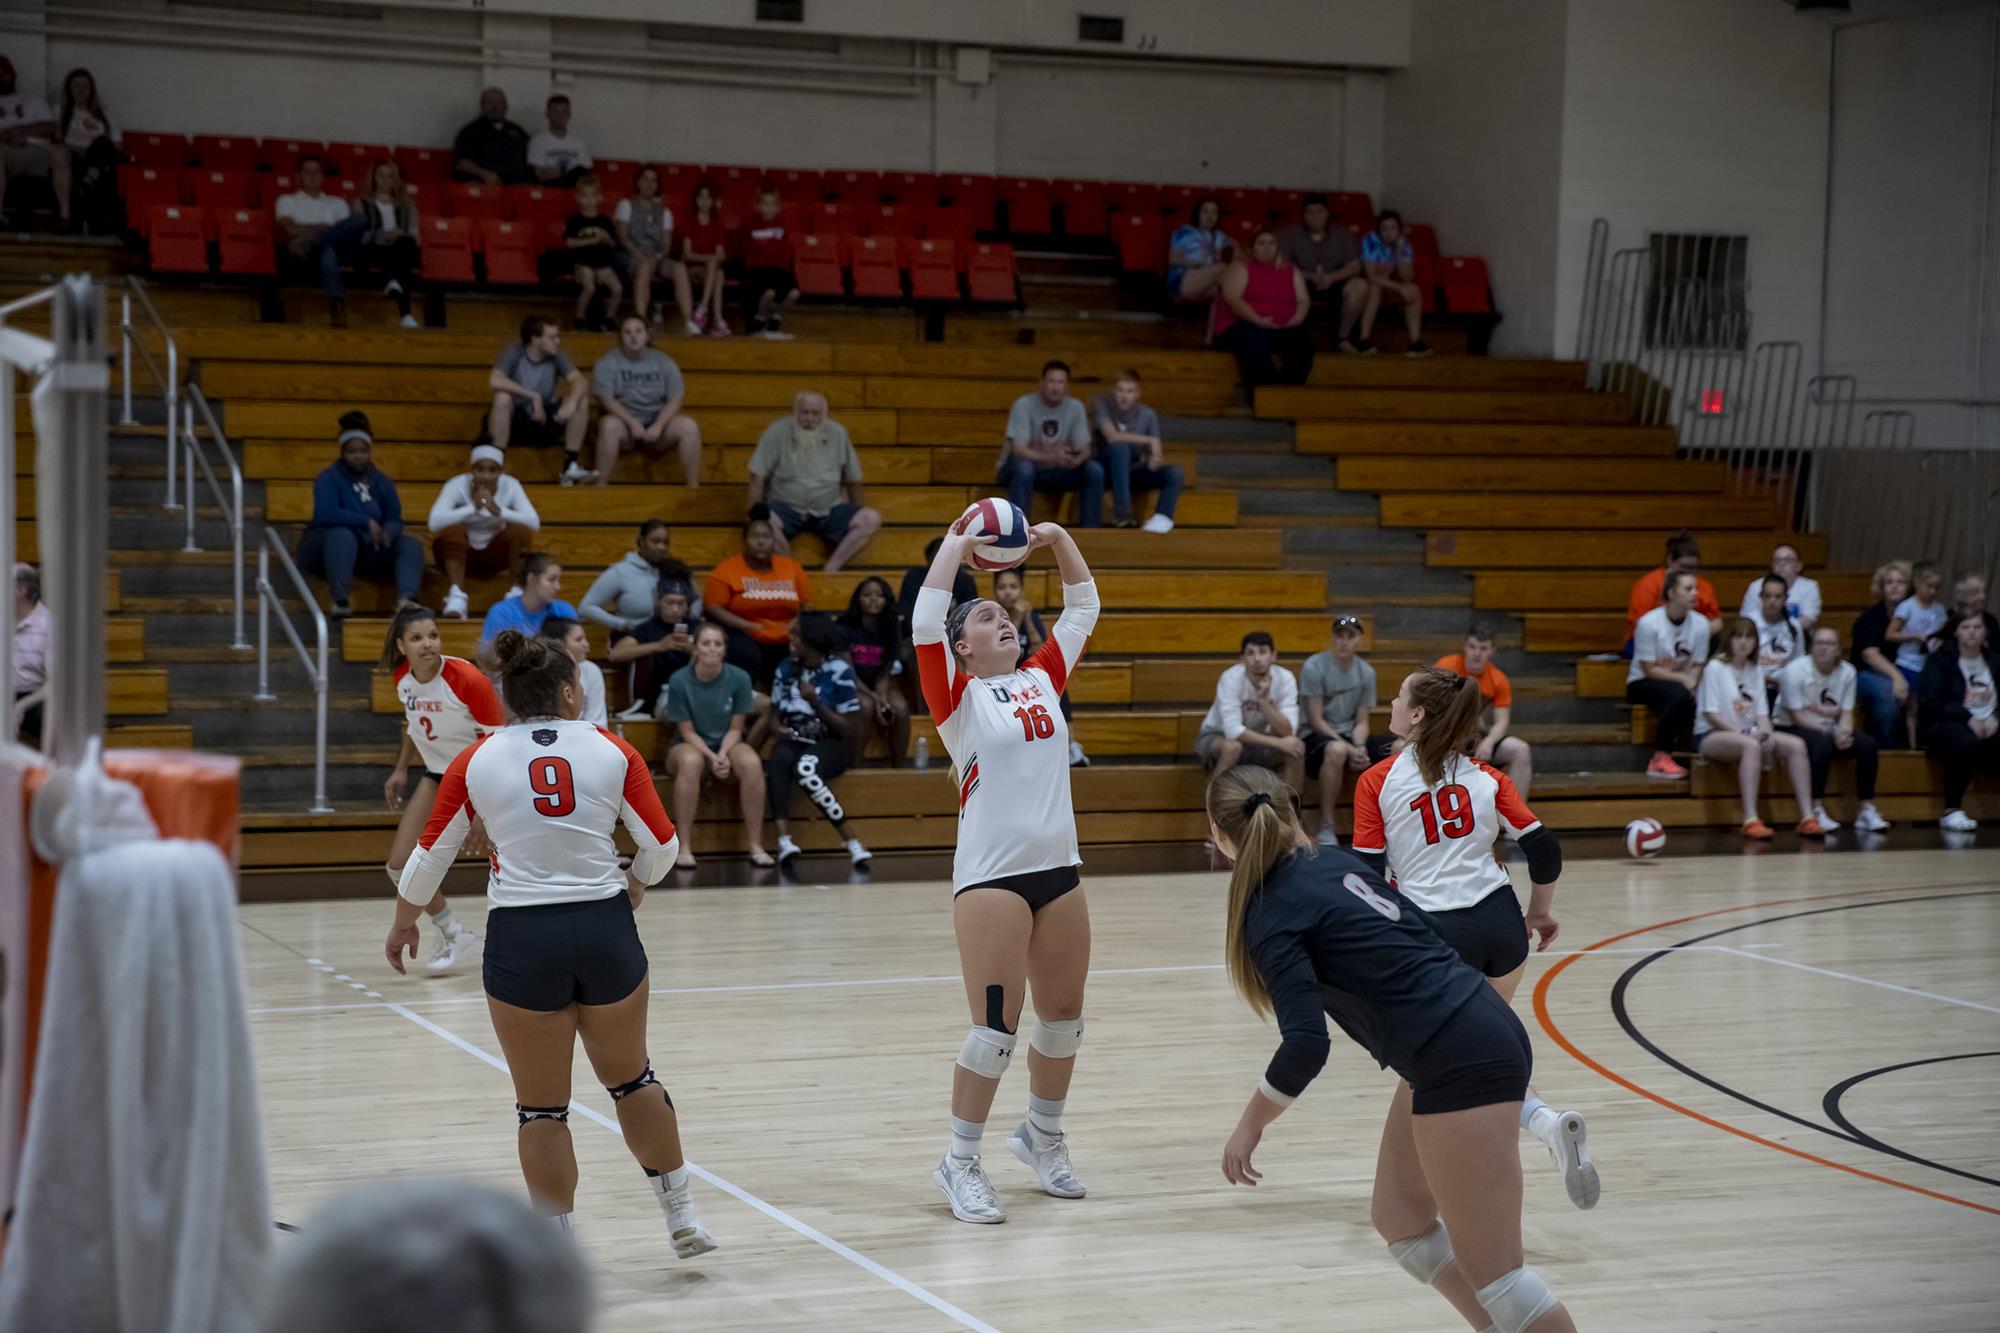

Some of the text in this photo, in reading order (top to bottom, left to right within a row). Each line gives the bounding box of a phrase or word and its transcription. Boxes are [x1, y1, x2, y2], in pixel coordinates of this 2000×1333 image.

[419, 716, 439, 741] 2
[1013, 704, 1055, 742] 16
[528, 756, 576, 817] 9
[1409, 784, 1475, 845] 19
